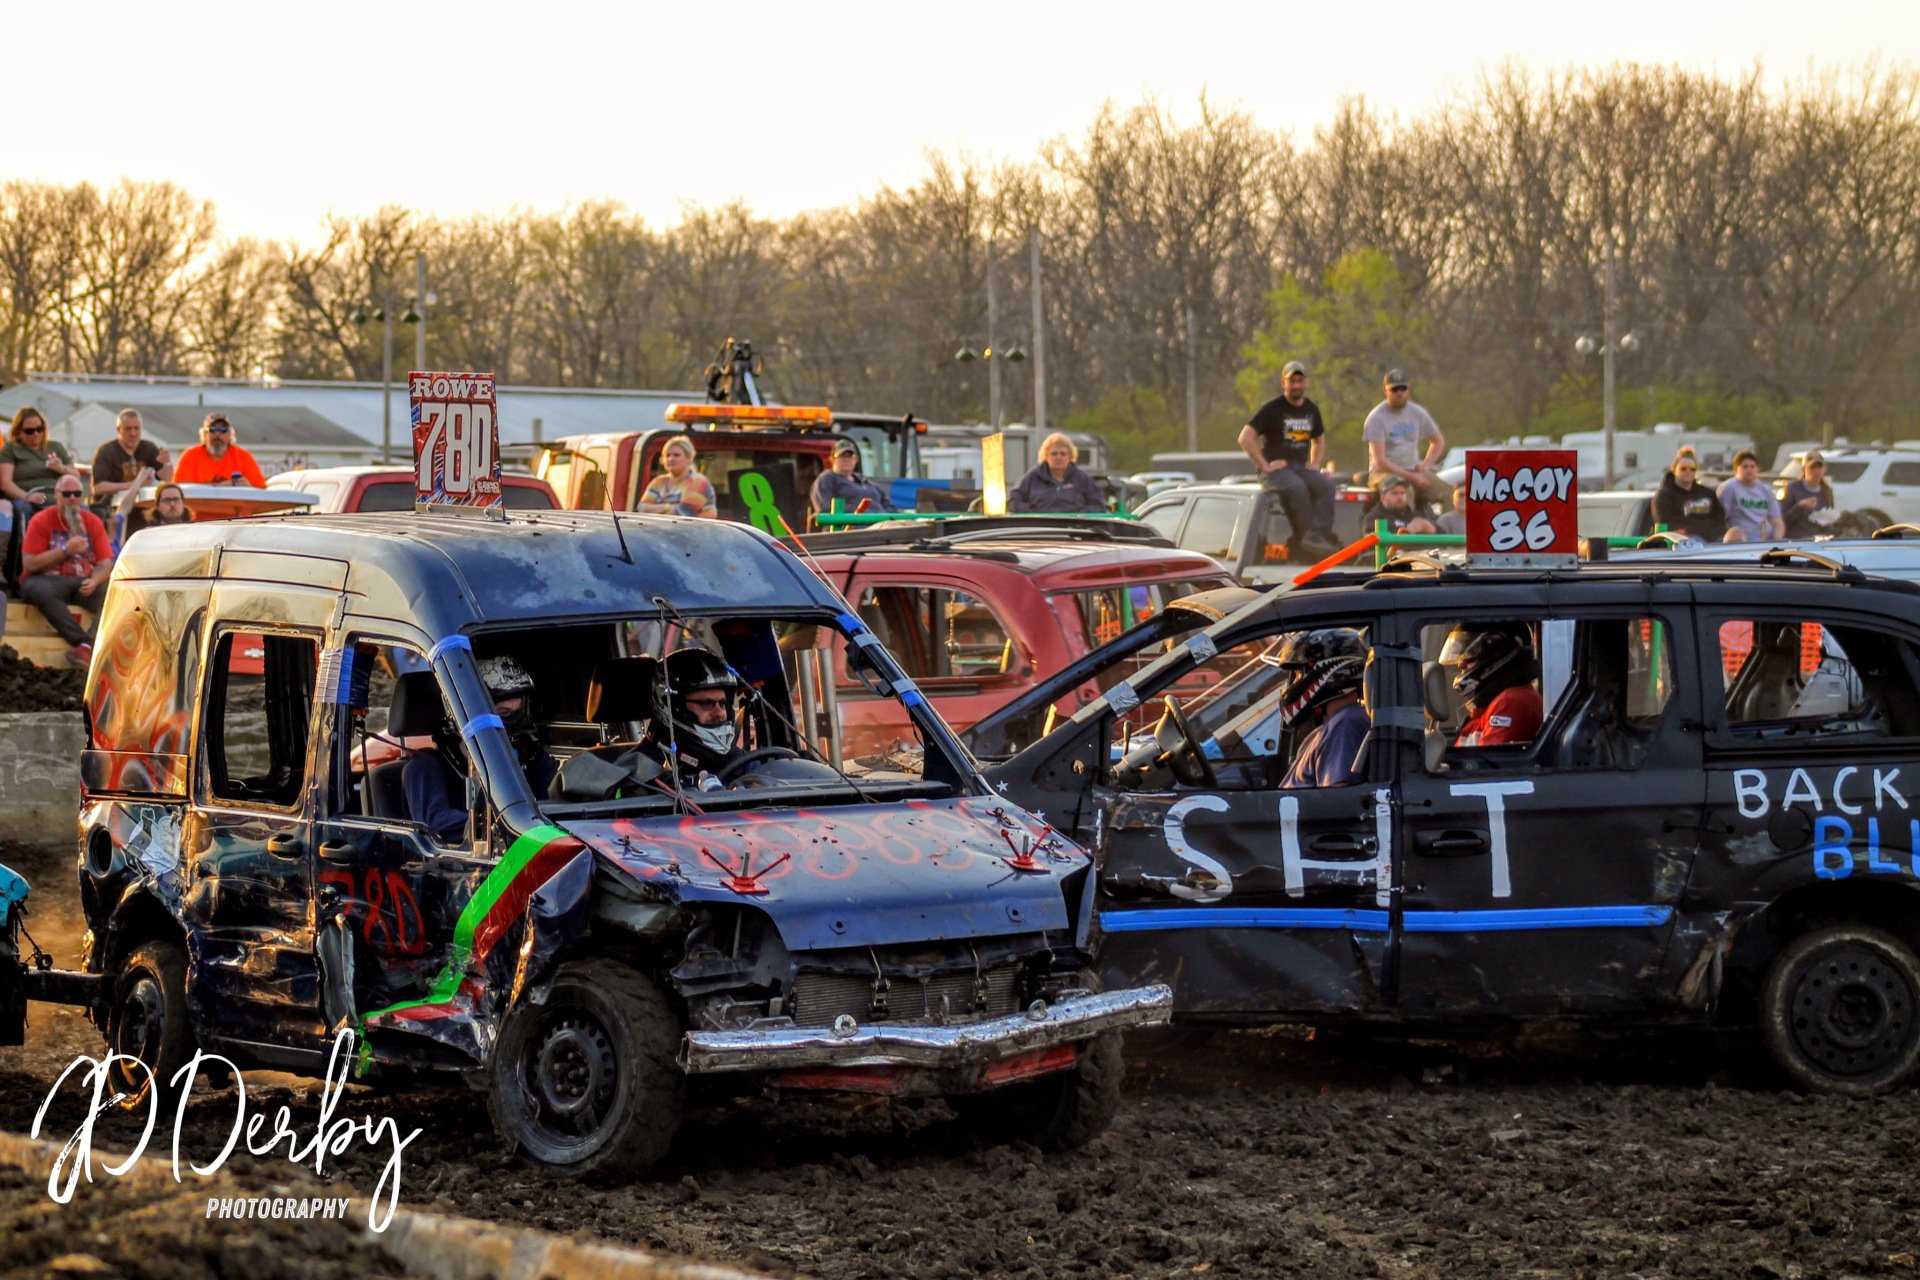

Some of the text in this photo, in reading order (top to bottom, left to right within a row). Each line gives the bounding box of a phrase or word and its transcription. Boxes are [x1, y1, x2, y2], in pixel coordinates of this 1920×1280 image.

[413, 378, 493, 400] ROWE
[1488, 508, 1557, 552] 86
[1733, 766, 1909, 818] BACK
